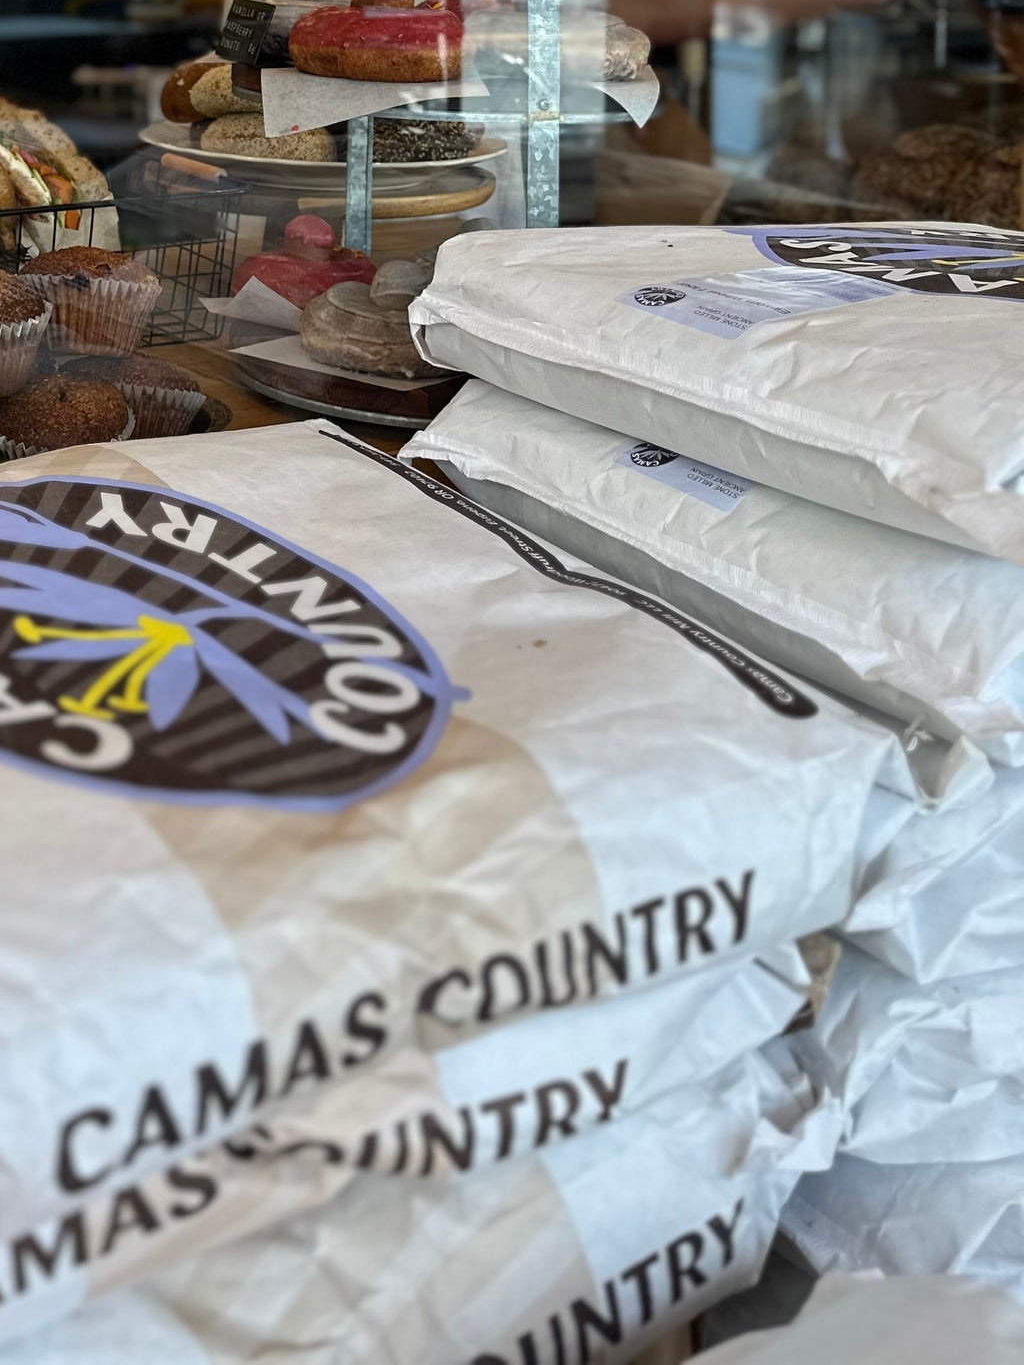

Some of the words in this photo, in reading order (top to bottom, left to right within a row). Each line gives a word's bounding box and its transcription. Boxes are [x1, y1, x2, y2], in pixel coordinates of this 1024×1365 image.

[779, 239, 1020, 292] AMAS
[693, 309, 721, 323] MILLED
[720, 318, 748, 331] STONE
[631, 452, 660, 467] CAMAS
[687, 473, 714, 489] MILLED
[690, 466, 715, 482] GRAIN
[712, 484, 740, 499] STONE
[713, 476, 745, 493] ANCIENT
[435, 489, 455, 501] OR
[498, 525, 534, 552] Street
[633, 598, 662, 612] LLC
[85, 491, 422, 754] COUNTRY
[661, 613, 691, 630] Mill
[689, 629, 746, 667] Country
[55, 988, 388, 1196] CAMAS
[414, 868, 756, 1030] COUNTRY
